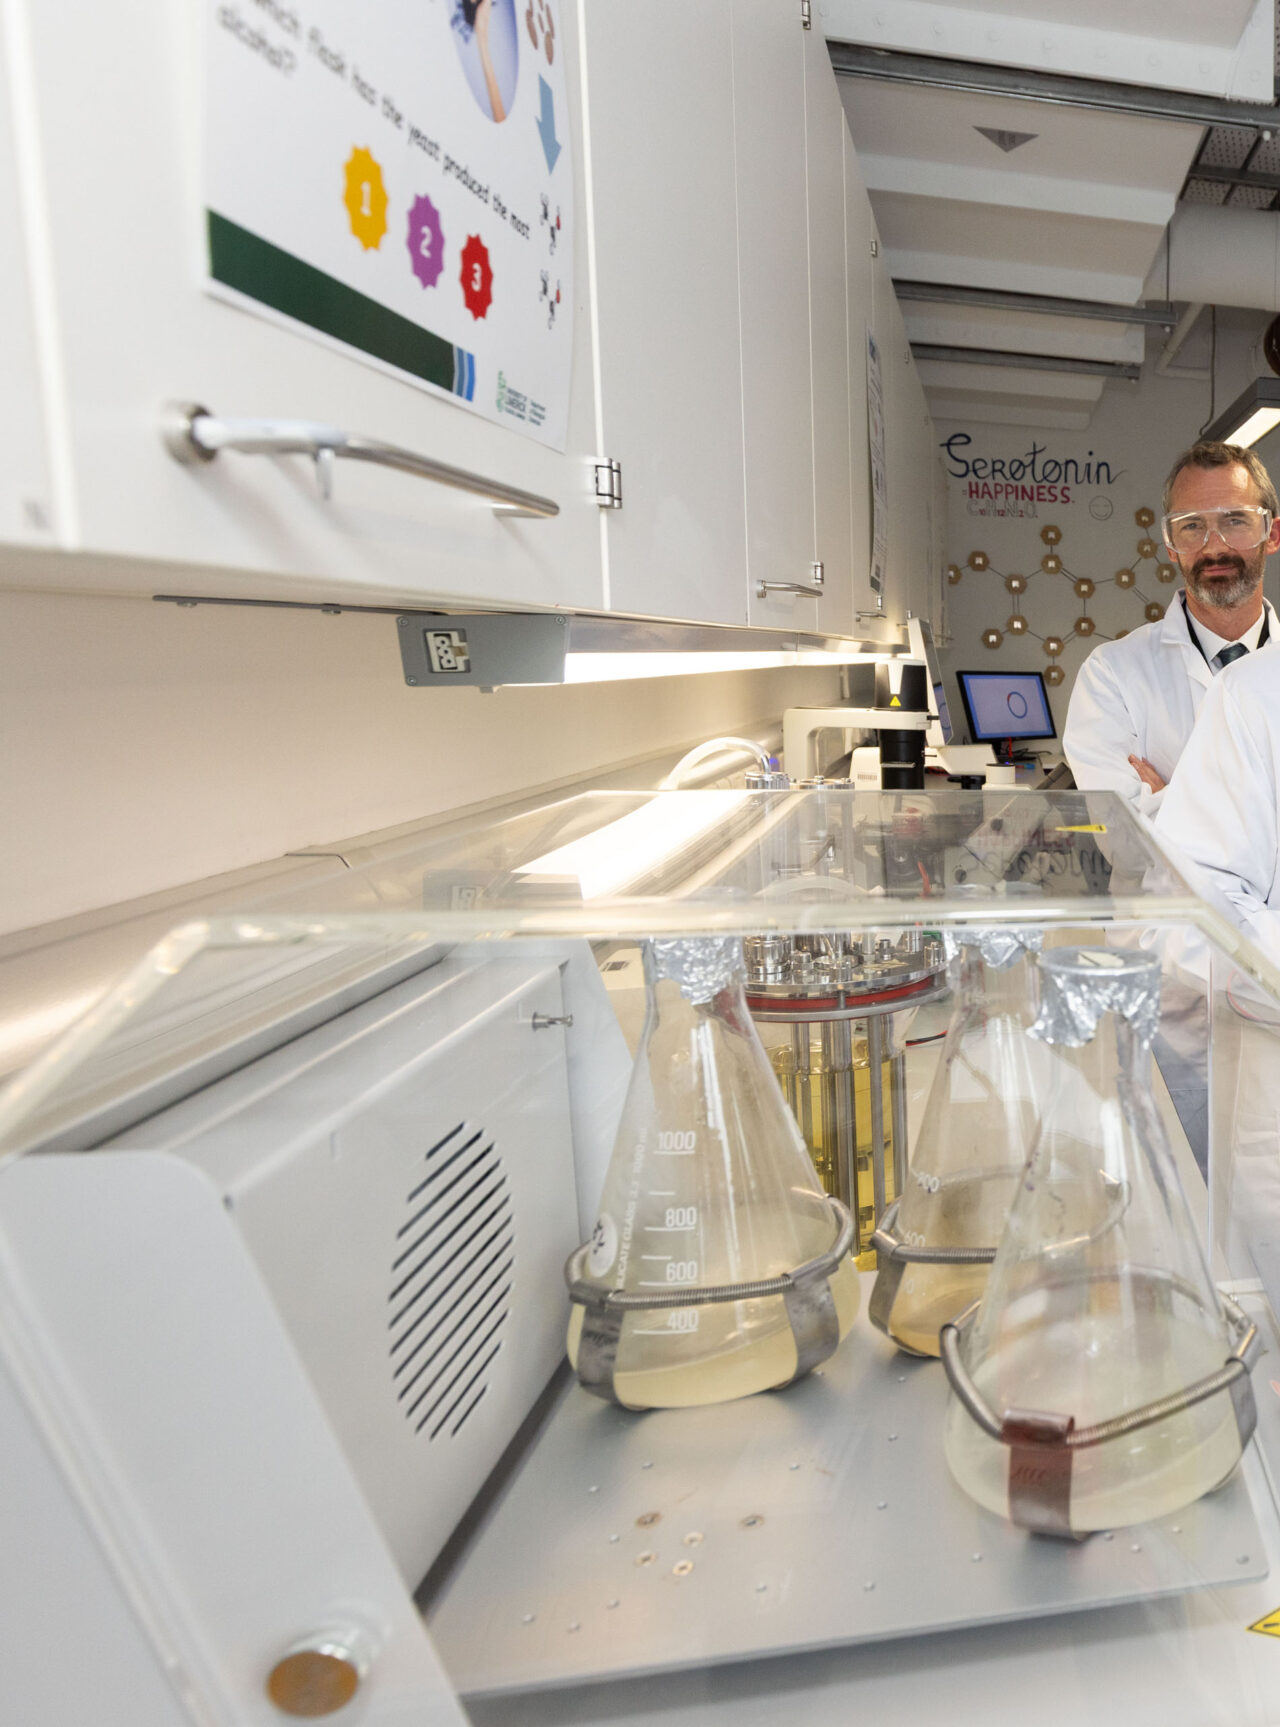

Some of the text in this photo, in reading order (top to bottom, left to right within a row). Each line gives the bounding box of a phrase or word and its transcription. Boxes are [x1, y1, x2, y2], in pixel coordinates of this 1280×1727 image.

[407, 123, 440, 161] yeast
[443, 155, 489, 204] produced
[493, 194, 507, 219] the
[510, 213, 530, 240] most
[360, 180, 482, 292] 1 2 3
[658, 1131, 696, 1150] 1000
[665, 1207, 697, 1227] 800
[666, 1261, 698, 1281] 600
[667, 1310, 699, 1330] 400
